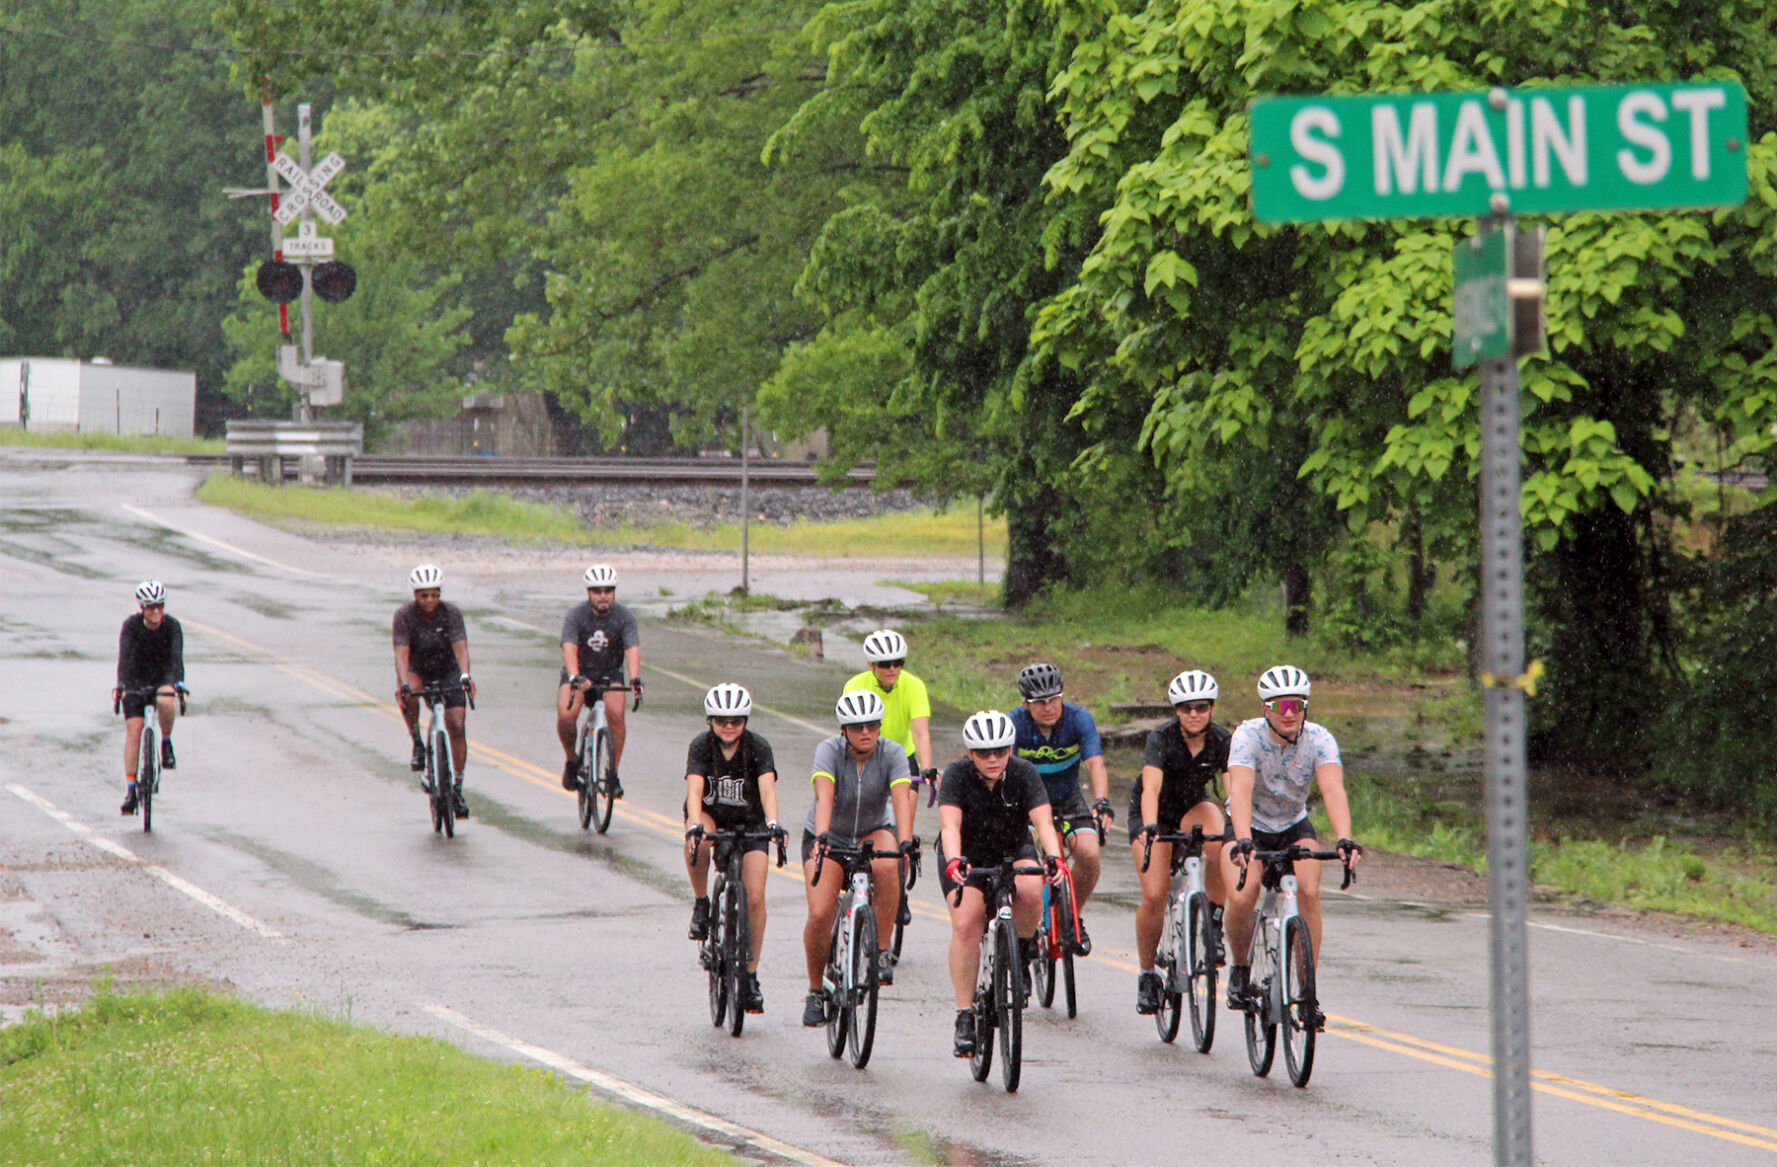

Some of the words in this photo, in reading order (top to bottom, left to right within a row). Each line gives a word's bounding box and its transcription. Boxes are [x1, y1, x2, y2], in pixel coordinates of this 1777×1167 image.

[1290, 106, 1345, 200] S
[1371, 94, 1588, 196] MAIN
[1617, 88, 1726, 185] ST
